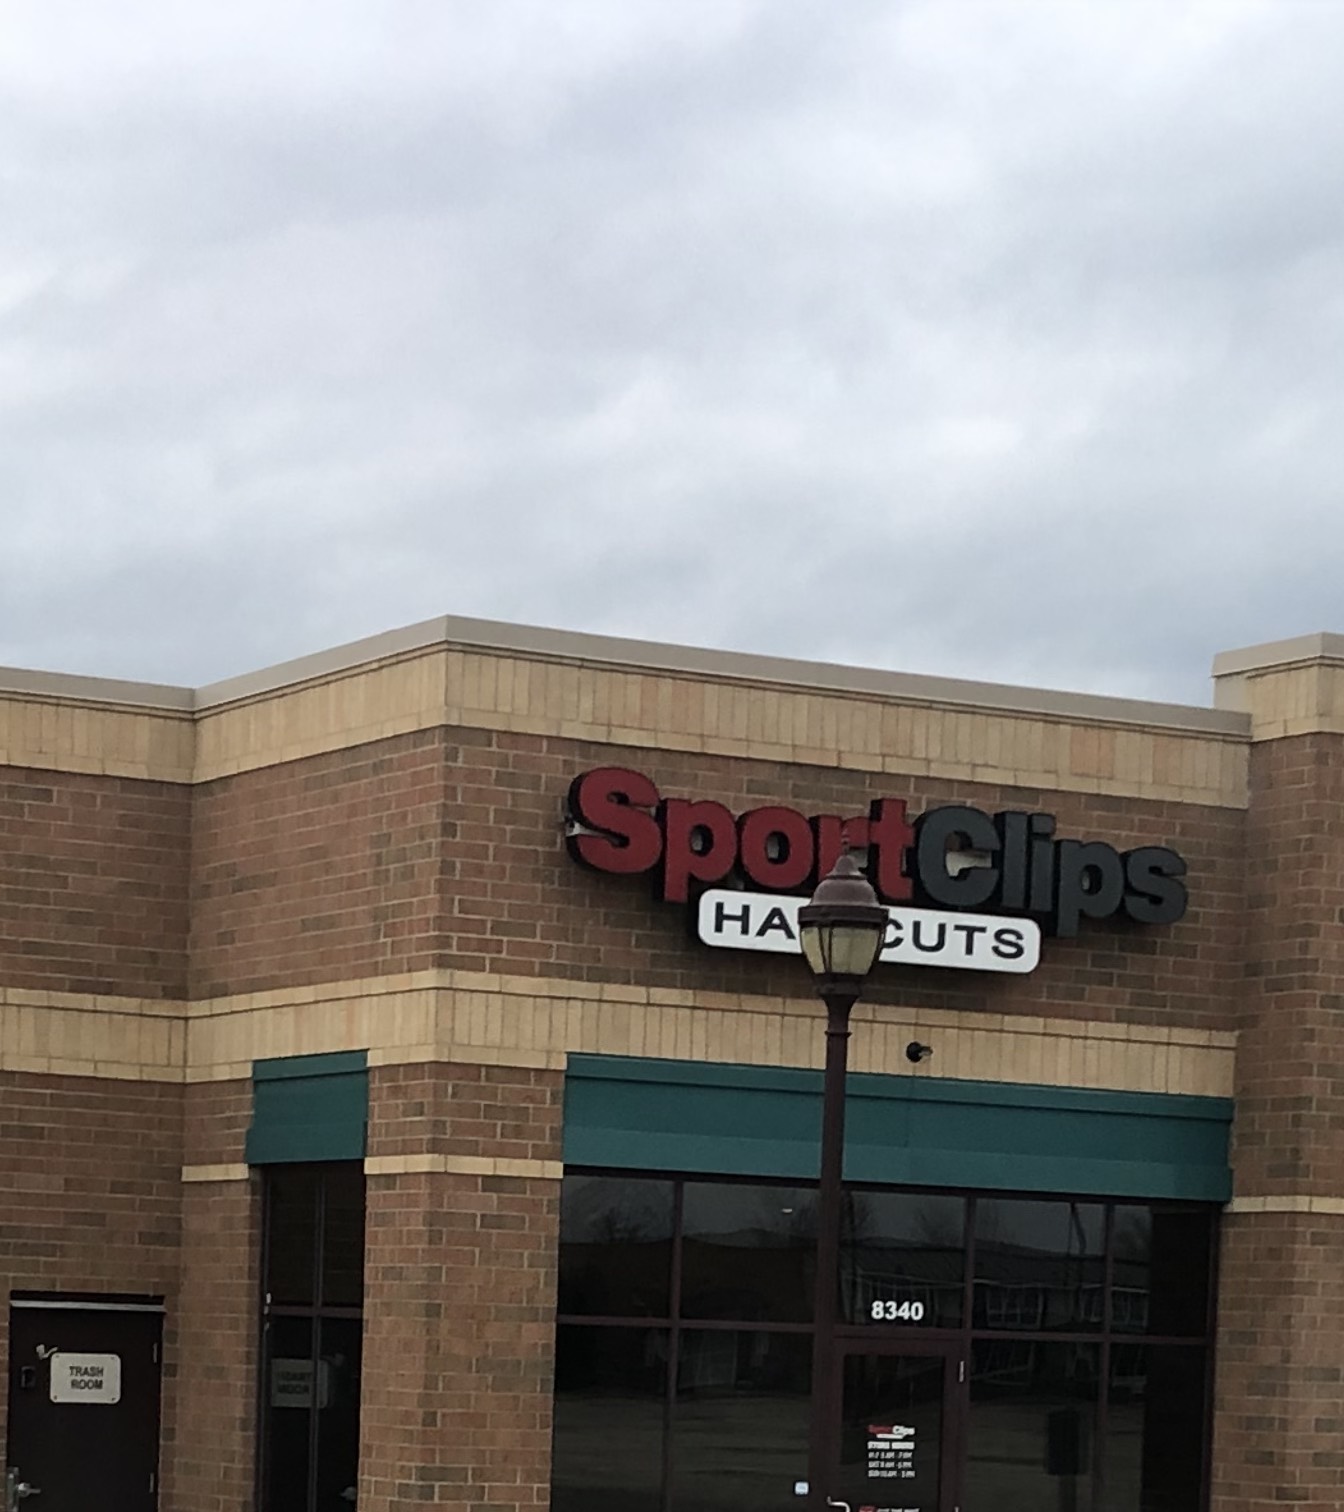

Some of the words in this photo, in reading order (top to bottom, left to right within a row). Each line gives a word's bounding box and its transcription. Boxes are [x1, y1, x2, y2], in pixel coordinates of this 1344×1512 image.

[713, 901, 1026, 960] HACUTS
[871, 1300, 924, 1320] 8340
[69, 1366, 104, 1377] TRASH
[71, 1379, 103, 1390] ROOM
